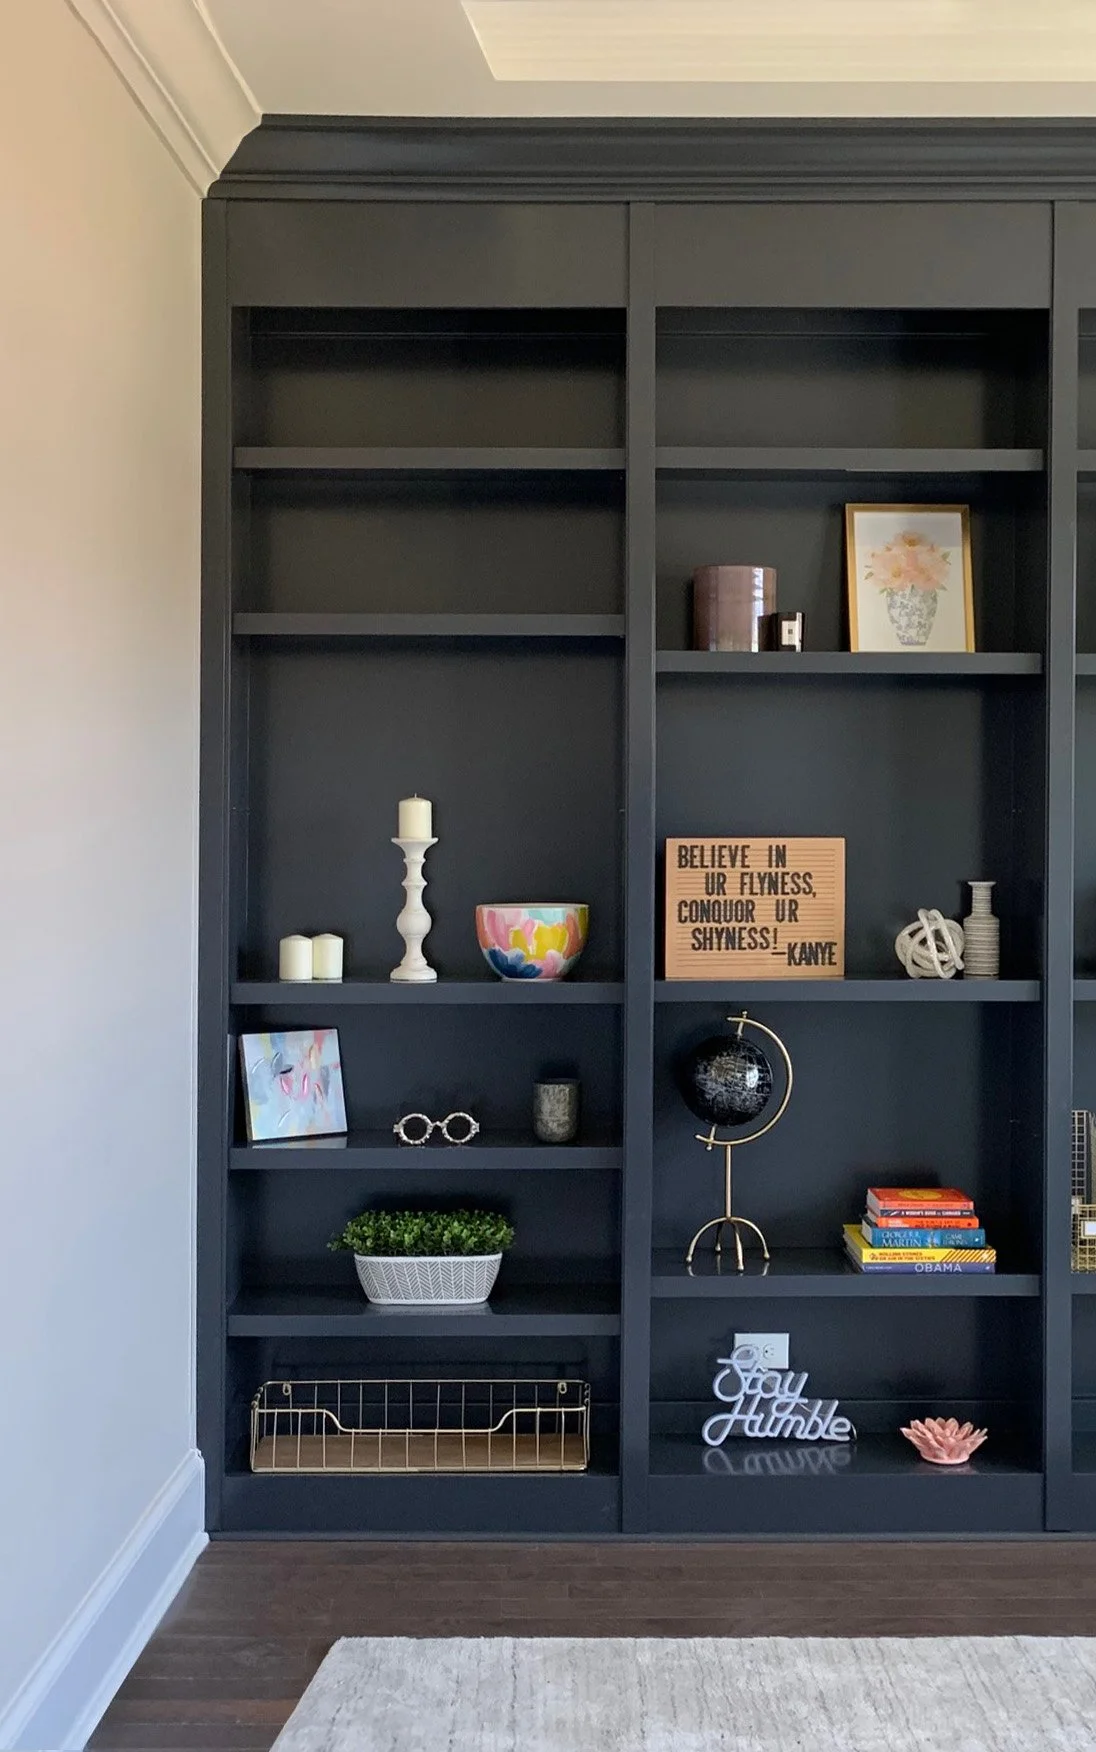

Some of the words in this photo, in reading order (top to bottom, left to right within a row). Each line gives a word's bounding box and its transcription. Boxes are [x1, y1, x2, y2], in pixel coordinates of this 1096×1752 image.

[677, 844, 750, 869] BELIEVE
[767, 844, 787, 869] IN
[704, 871, 728, 897] UR
[739, 871, 817, 898] FLYNESS,
[677, 899, 756, 925] CONQUOR
[775, 899, 799, 923] UR
[691, 926, 778, 952] SHYNESS!
[881, 1238, 922, 1247] MARTIN
[914, 1263, 963, 1273] OBAMA
[713, 1344, 808, 1418] Stay
[702, 1395, 851, 1446] Humble
